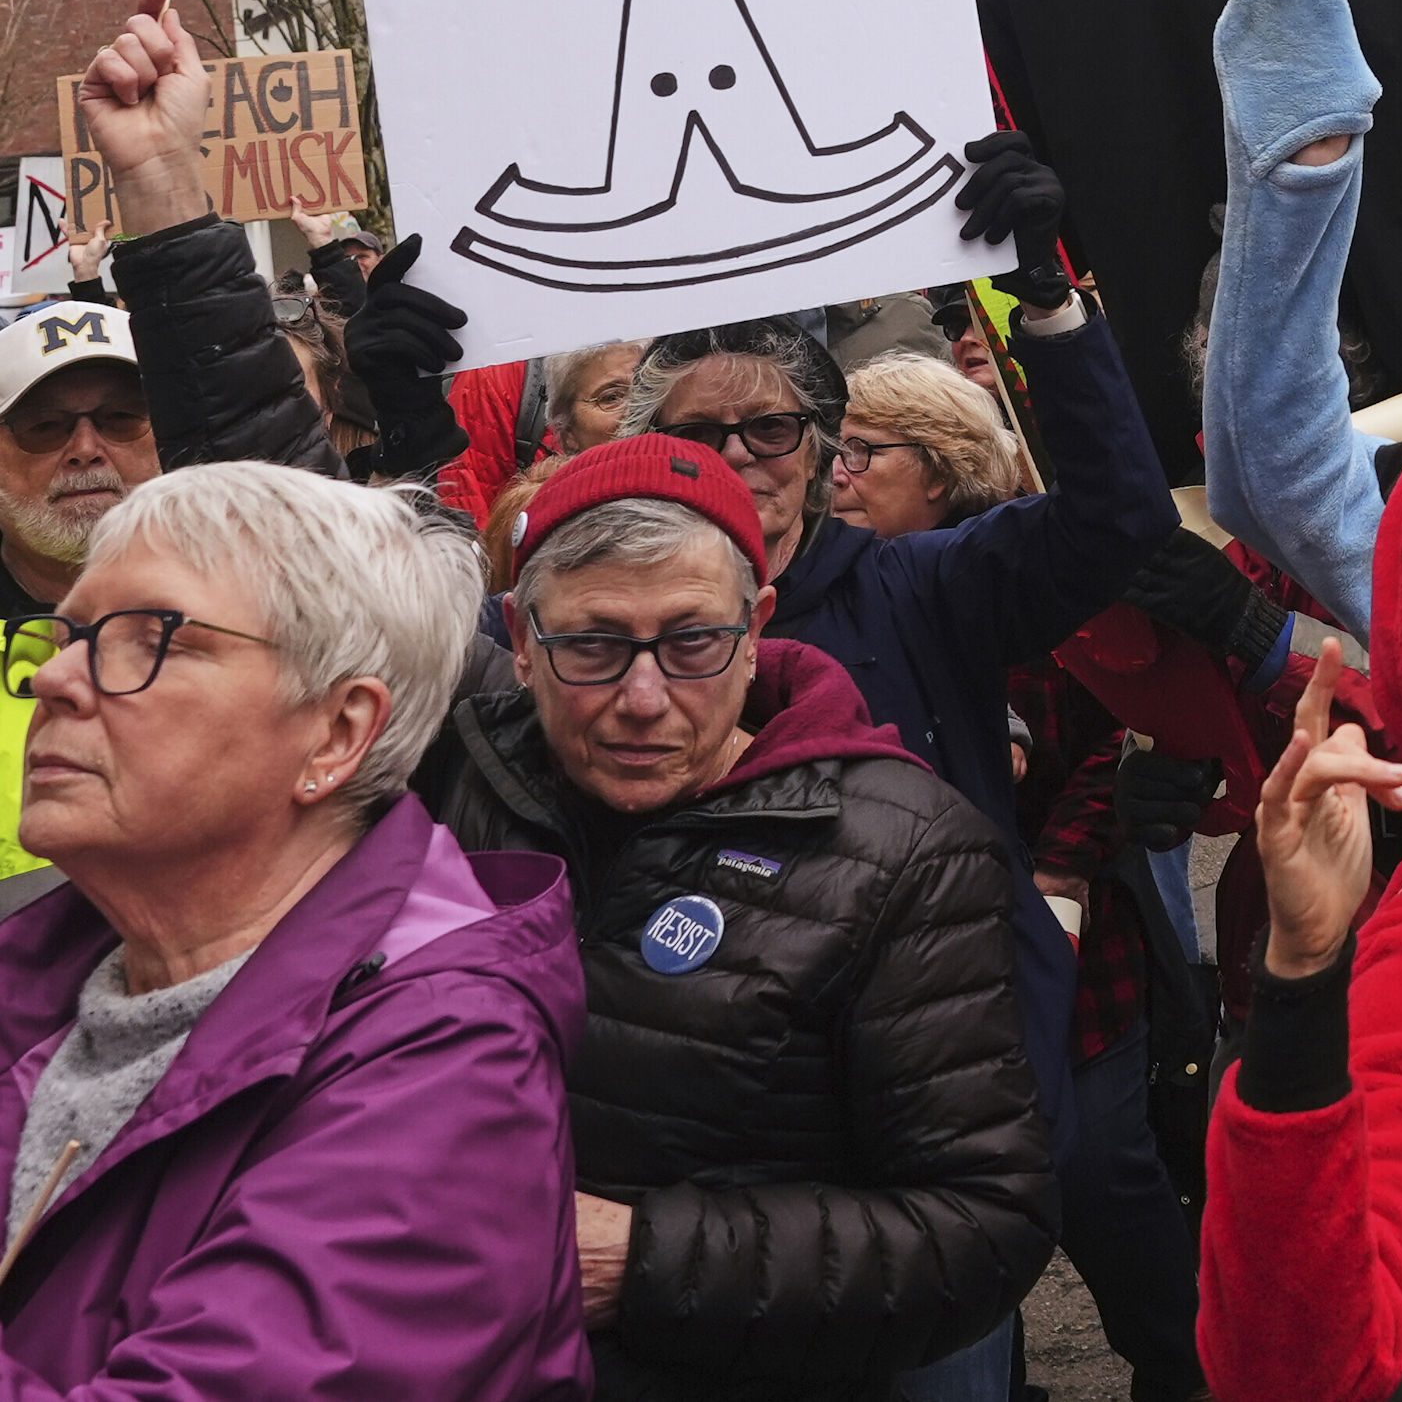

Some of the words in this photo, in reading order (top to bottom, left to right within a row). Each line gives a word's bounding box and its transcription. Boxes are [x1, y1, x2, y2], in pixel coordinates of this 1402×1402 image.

[72, 56, 350, 153] IEACH
[221, 130, 365, 215] MUSK
[717, 856, 773, 877] patagonia
[647, 906, 715, 961] RESIST
